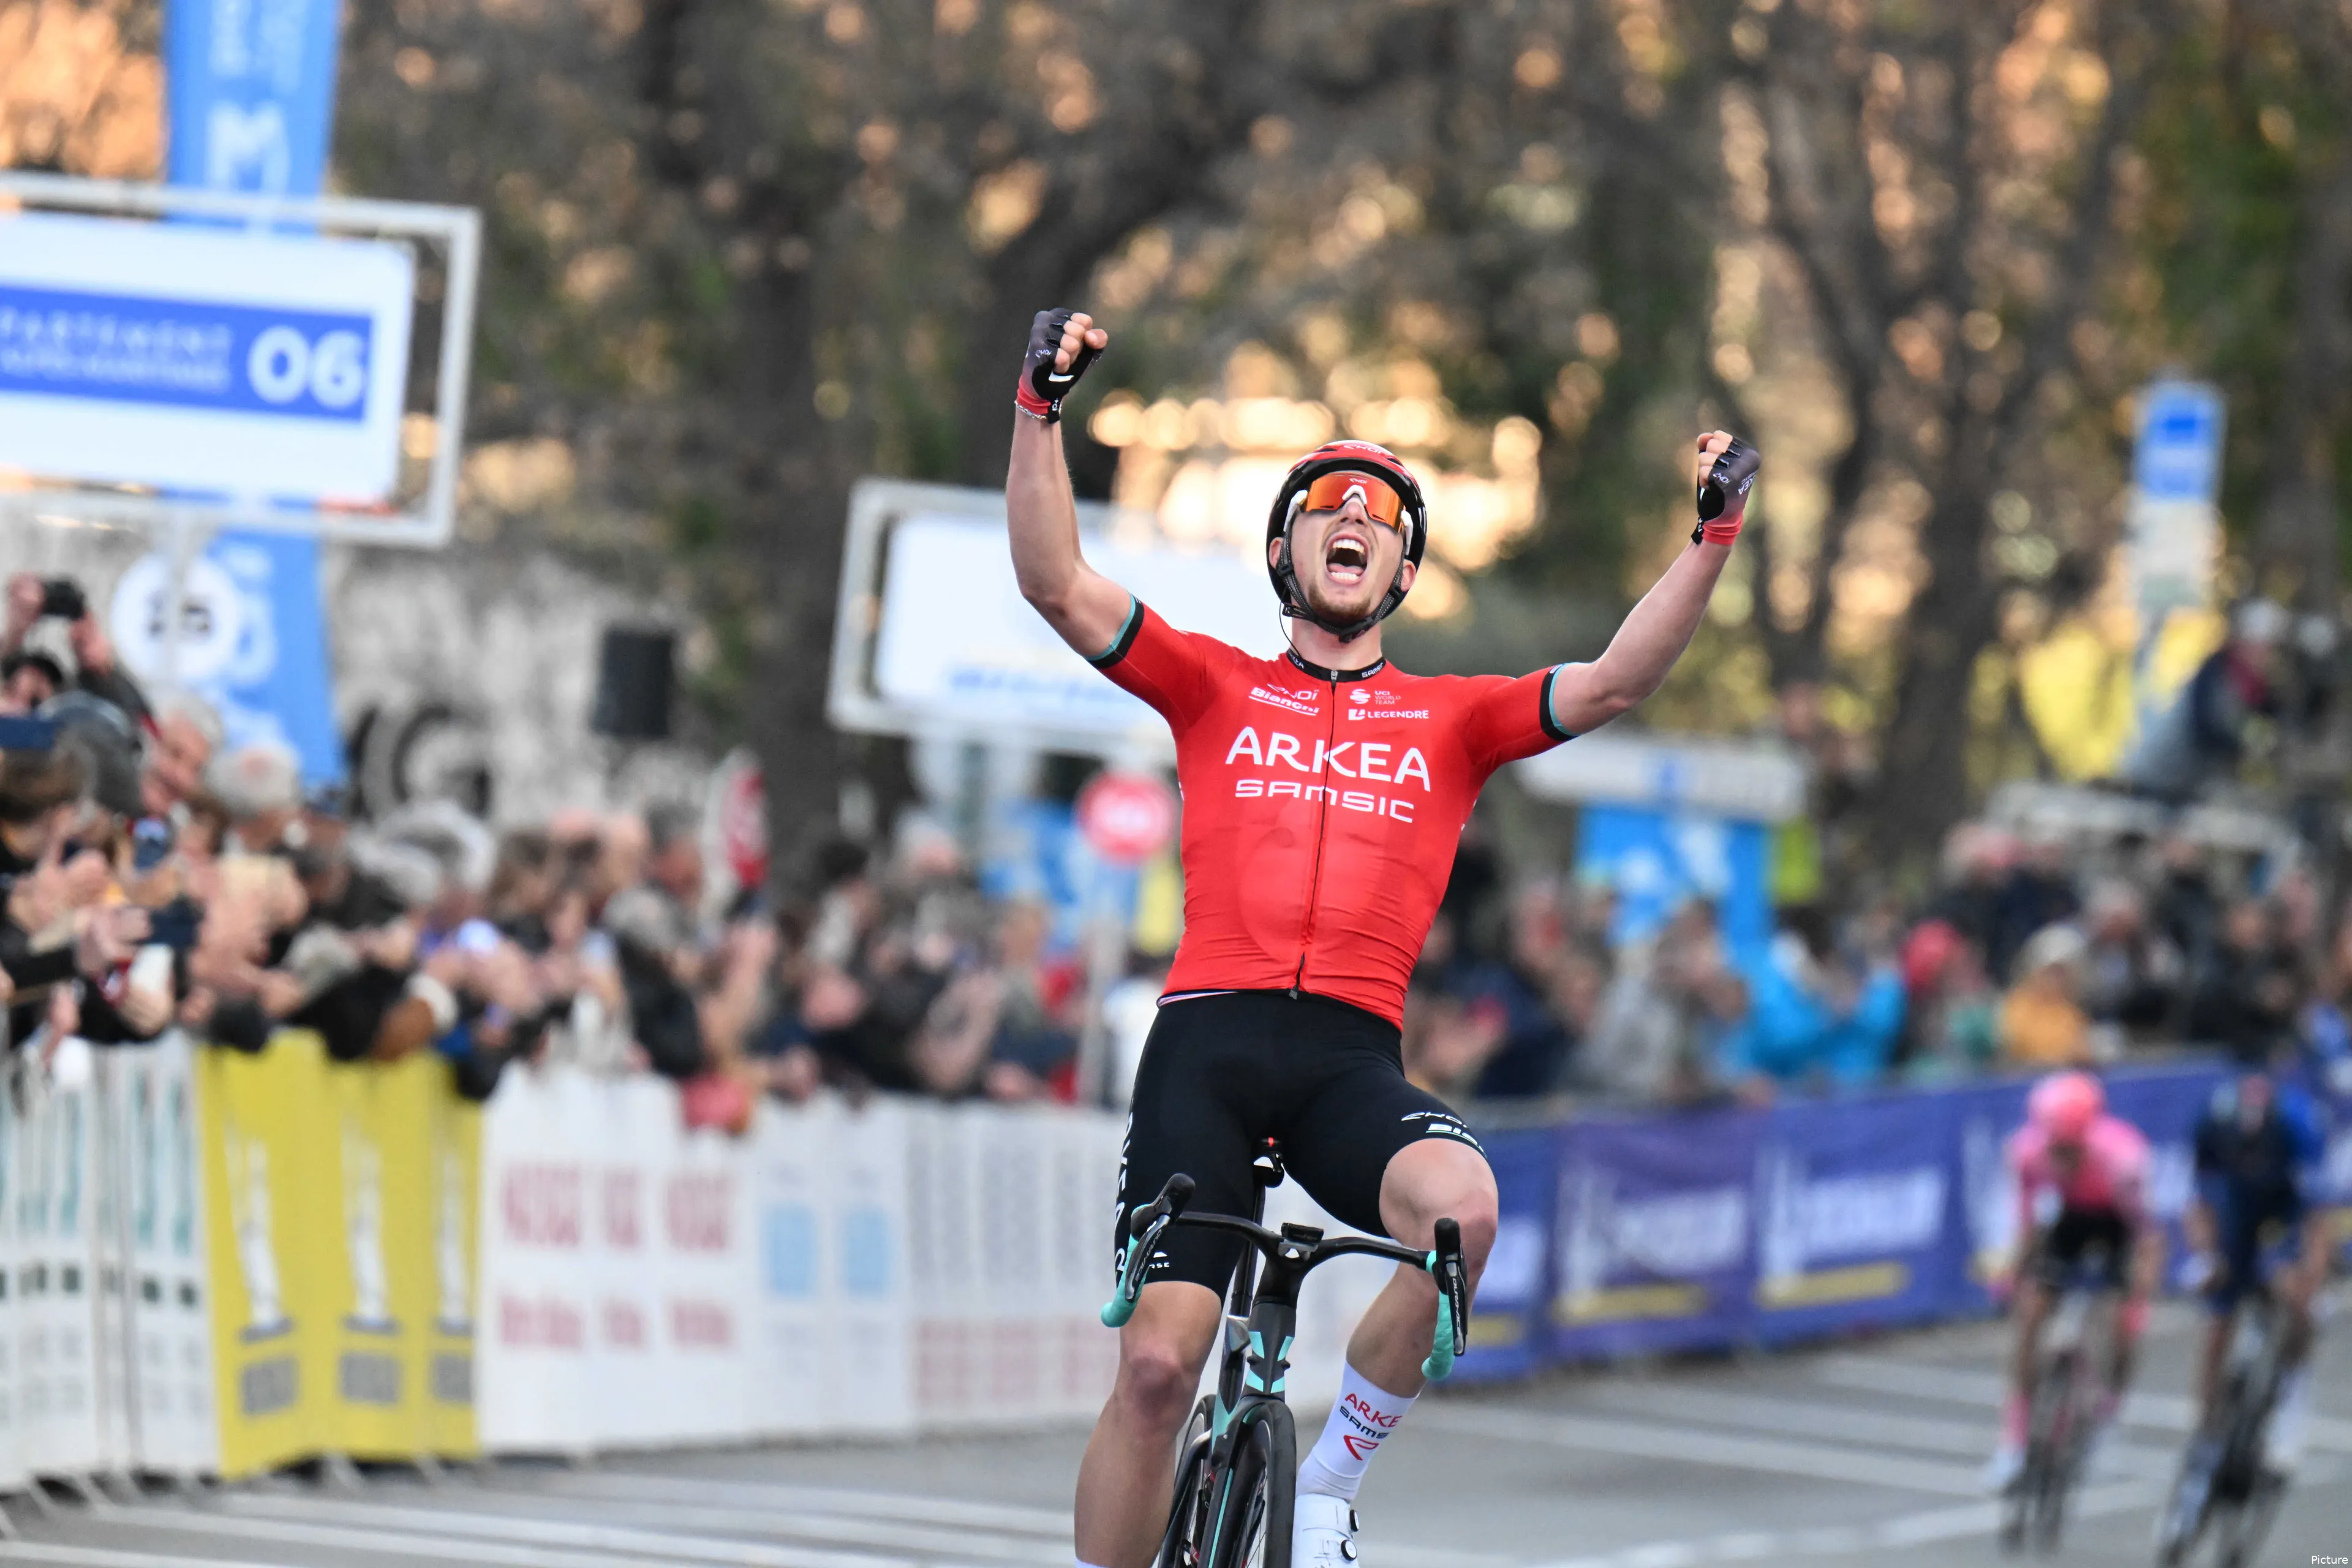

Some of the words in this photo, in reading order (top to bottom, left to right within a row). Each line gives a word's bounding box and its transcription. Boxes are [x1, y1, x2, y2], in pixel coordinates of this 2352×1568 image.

[249, 326, 366, 409] 06
[1251, 687, 1319, 714] Bianchi
[1367, 710, 1429, 719] LEGENDRE
[1226, 726, 1431, 792] ARKEA
[1235, 780, 1414, 823] SAMSIC
[1452, 1278, 1462, 1336] DURA-ACE
[1340, 1405, 1389, 1439] SAMS
[1345, 1393, 1403, 1428] ARKE
